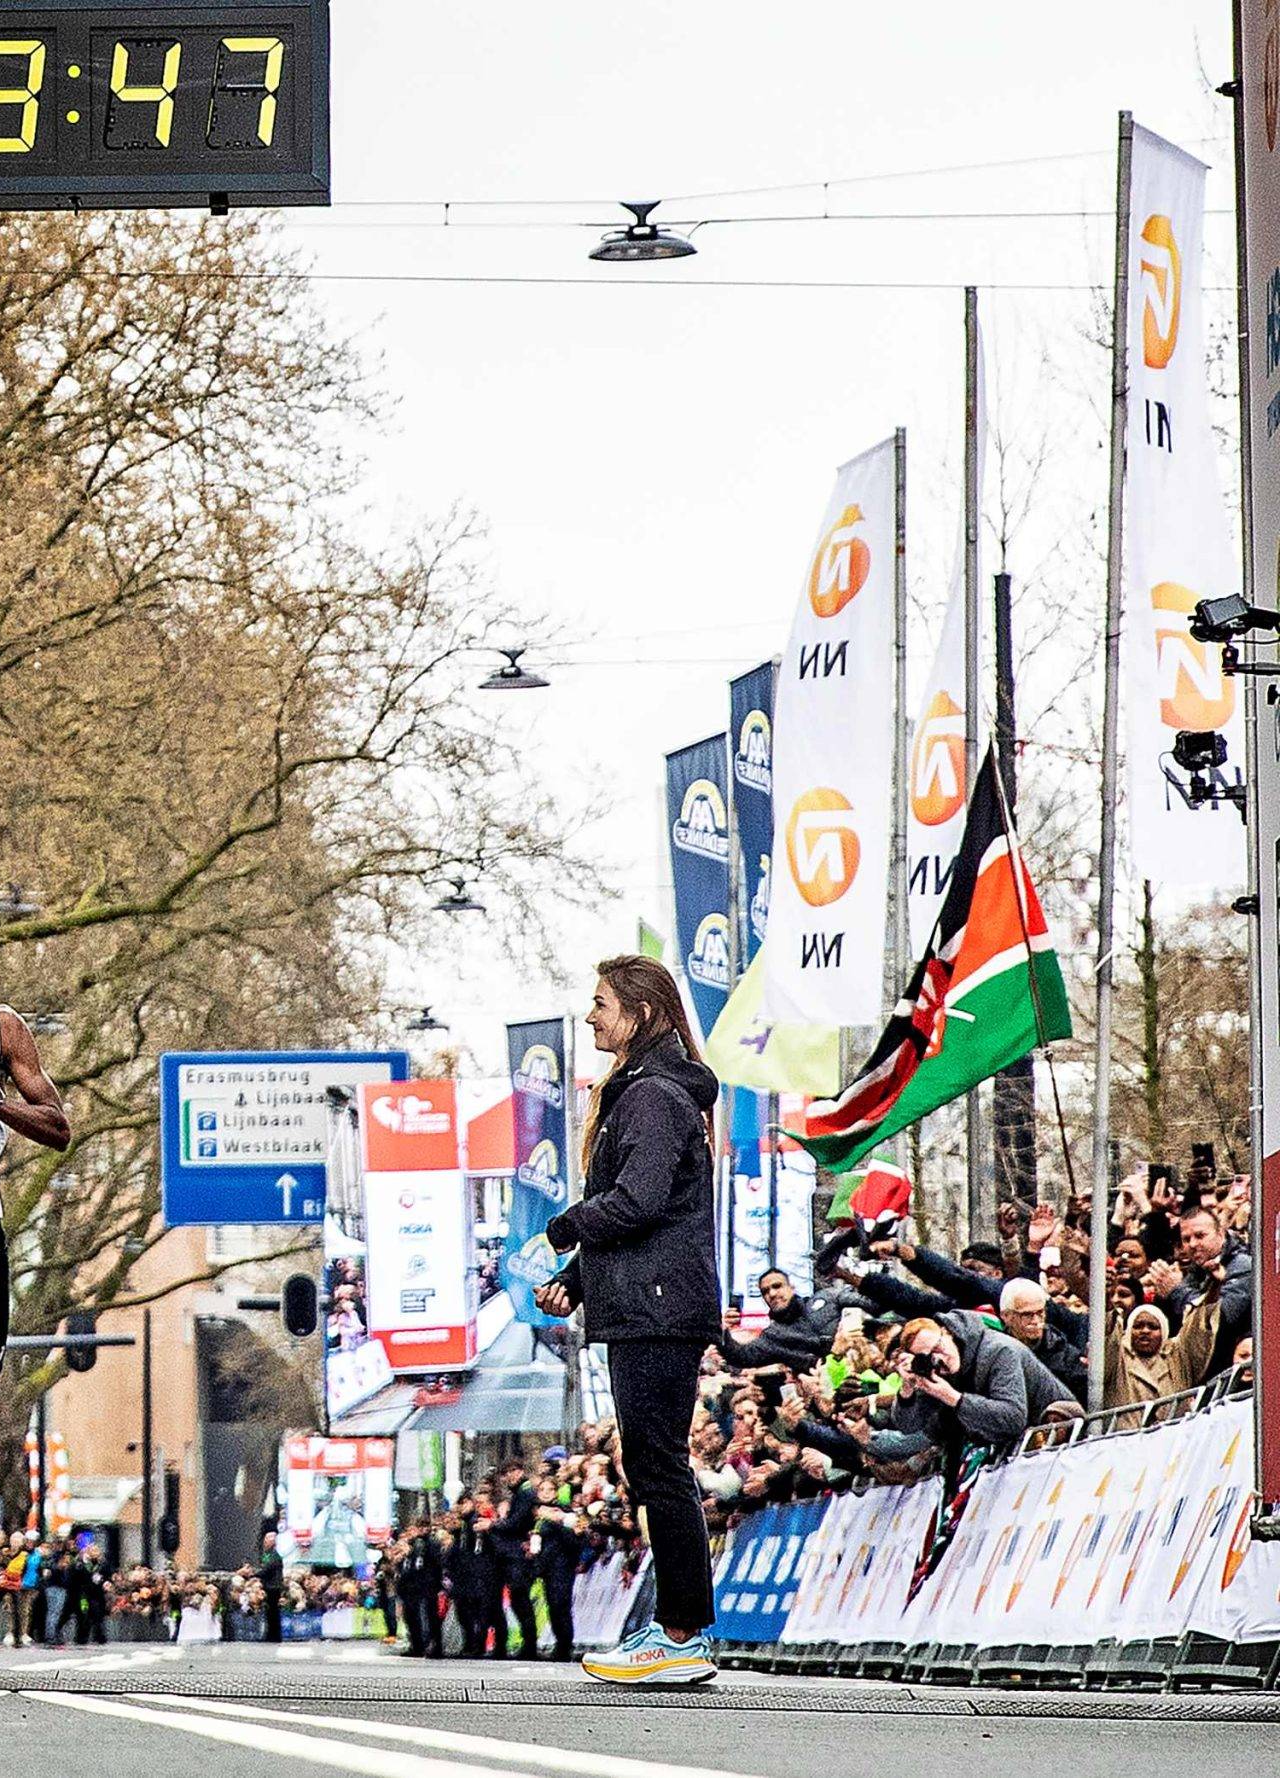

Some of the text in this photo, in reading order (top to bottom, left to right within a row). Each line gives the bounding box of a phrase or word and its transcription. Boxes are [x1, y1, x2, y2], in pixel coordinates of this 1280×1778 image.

[185, 1068, 311, 1086] Erasmusbrug
[256, 1090, 329, 1108] Lijnbaa
[223, 1112, 304, 1131] Lijnbaan
[224, 1138, 324, 1153] Westblaak
[629, 1647, 666, 1664] HOKA
